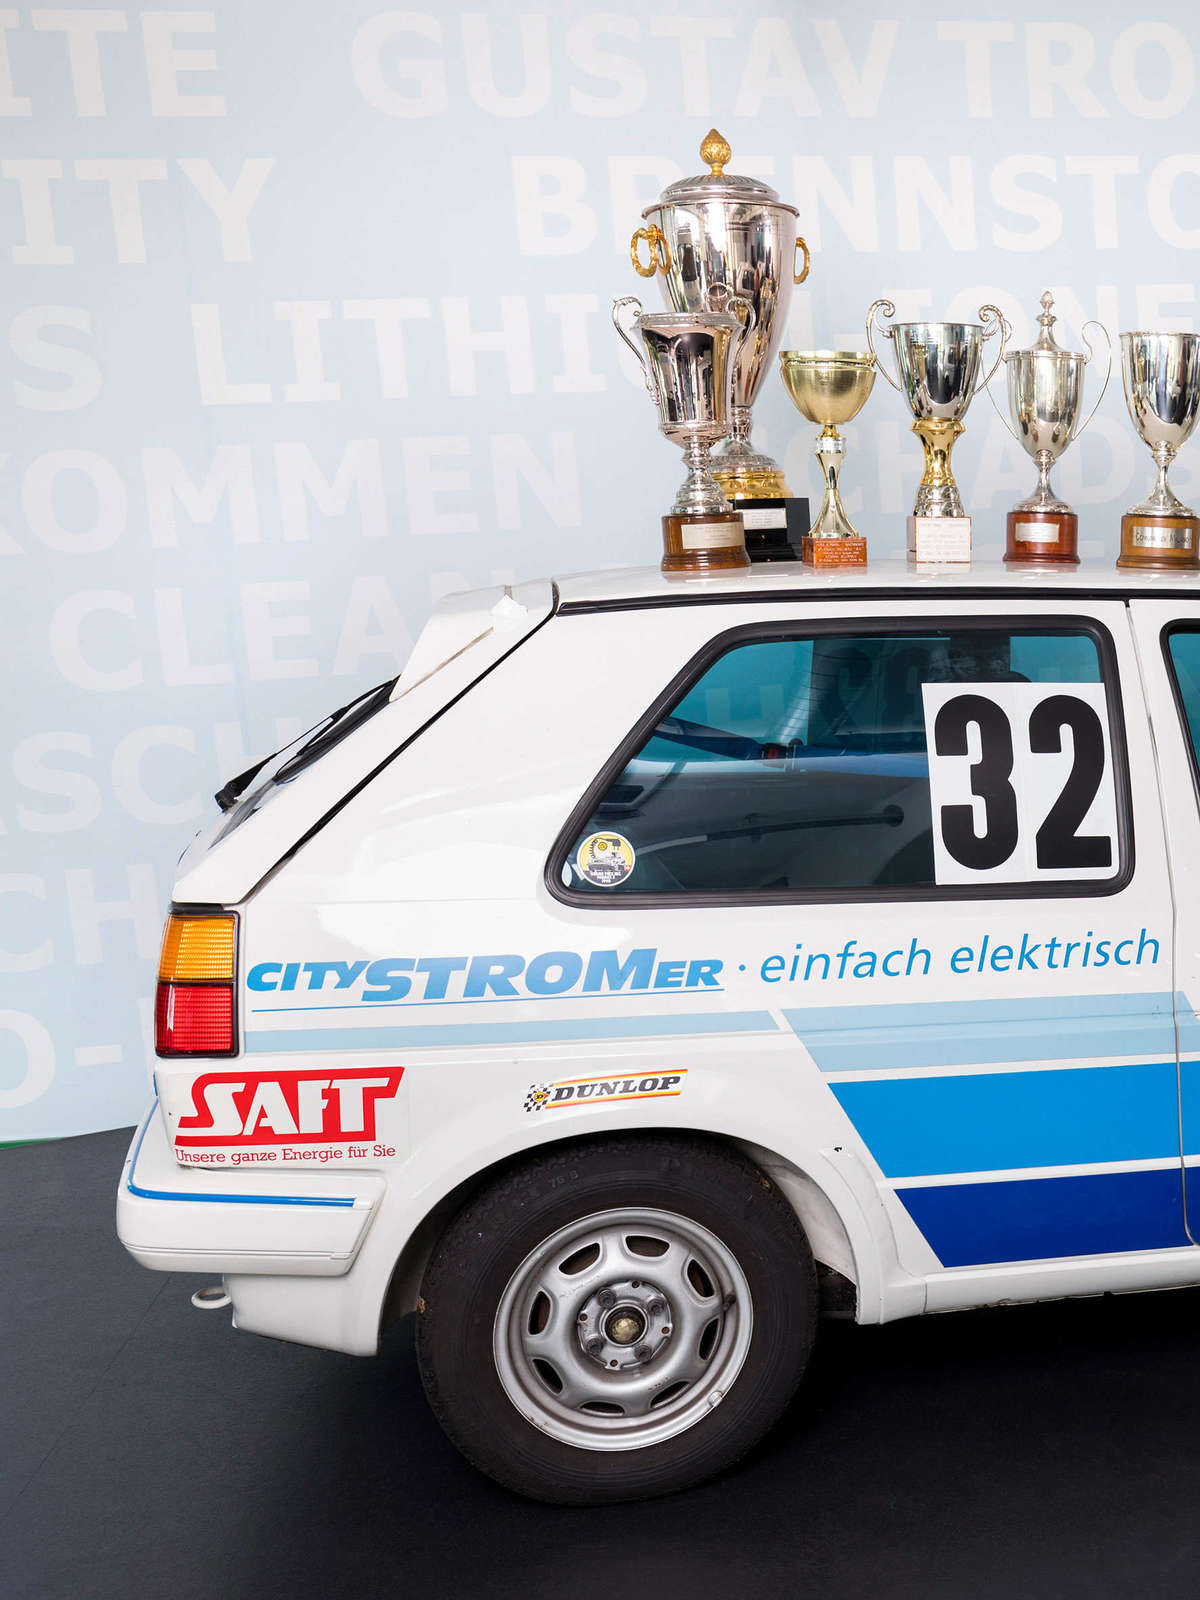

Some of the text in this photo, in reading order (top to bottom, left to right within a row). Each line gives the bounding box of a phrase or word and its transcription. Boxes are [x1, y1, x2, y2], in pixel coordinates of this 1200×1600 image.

[350, 11, 899, 119] GUSTAV
[2, 157, 277, 265] ITY
[0, 430, 584, 556] OMMEN
[934, 694, 1112, 870] 32
[760, 938, 931, 983] einfach
[950, 928, 1161, 973] elektrisch
[175, 1077, 390, 1137] SAFT
[552, 1076, 681, 1102] DUNLOP
[175, 1144, 396, 1166] Unsere ganze Energie für Sie
